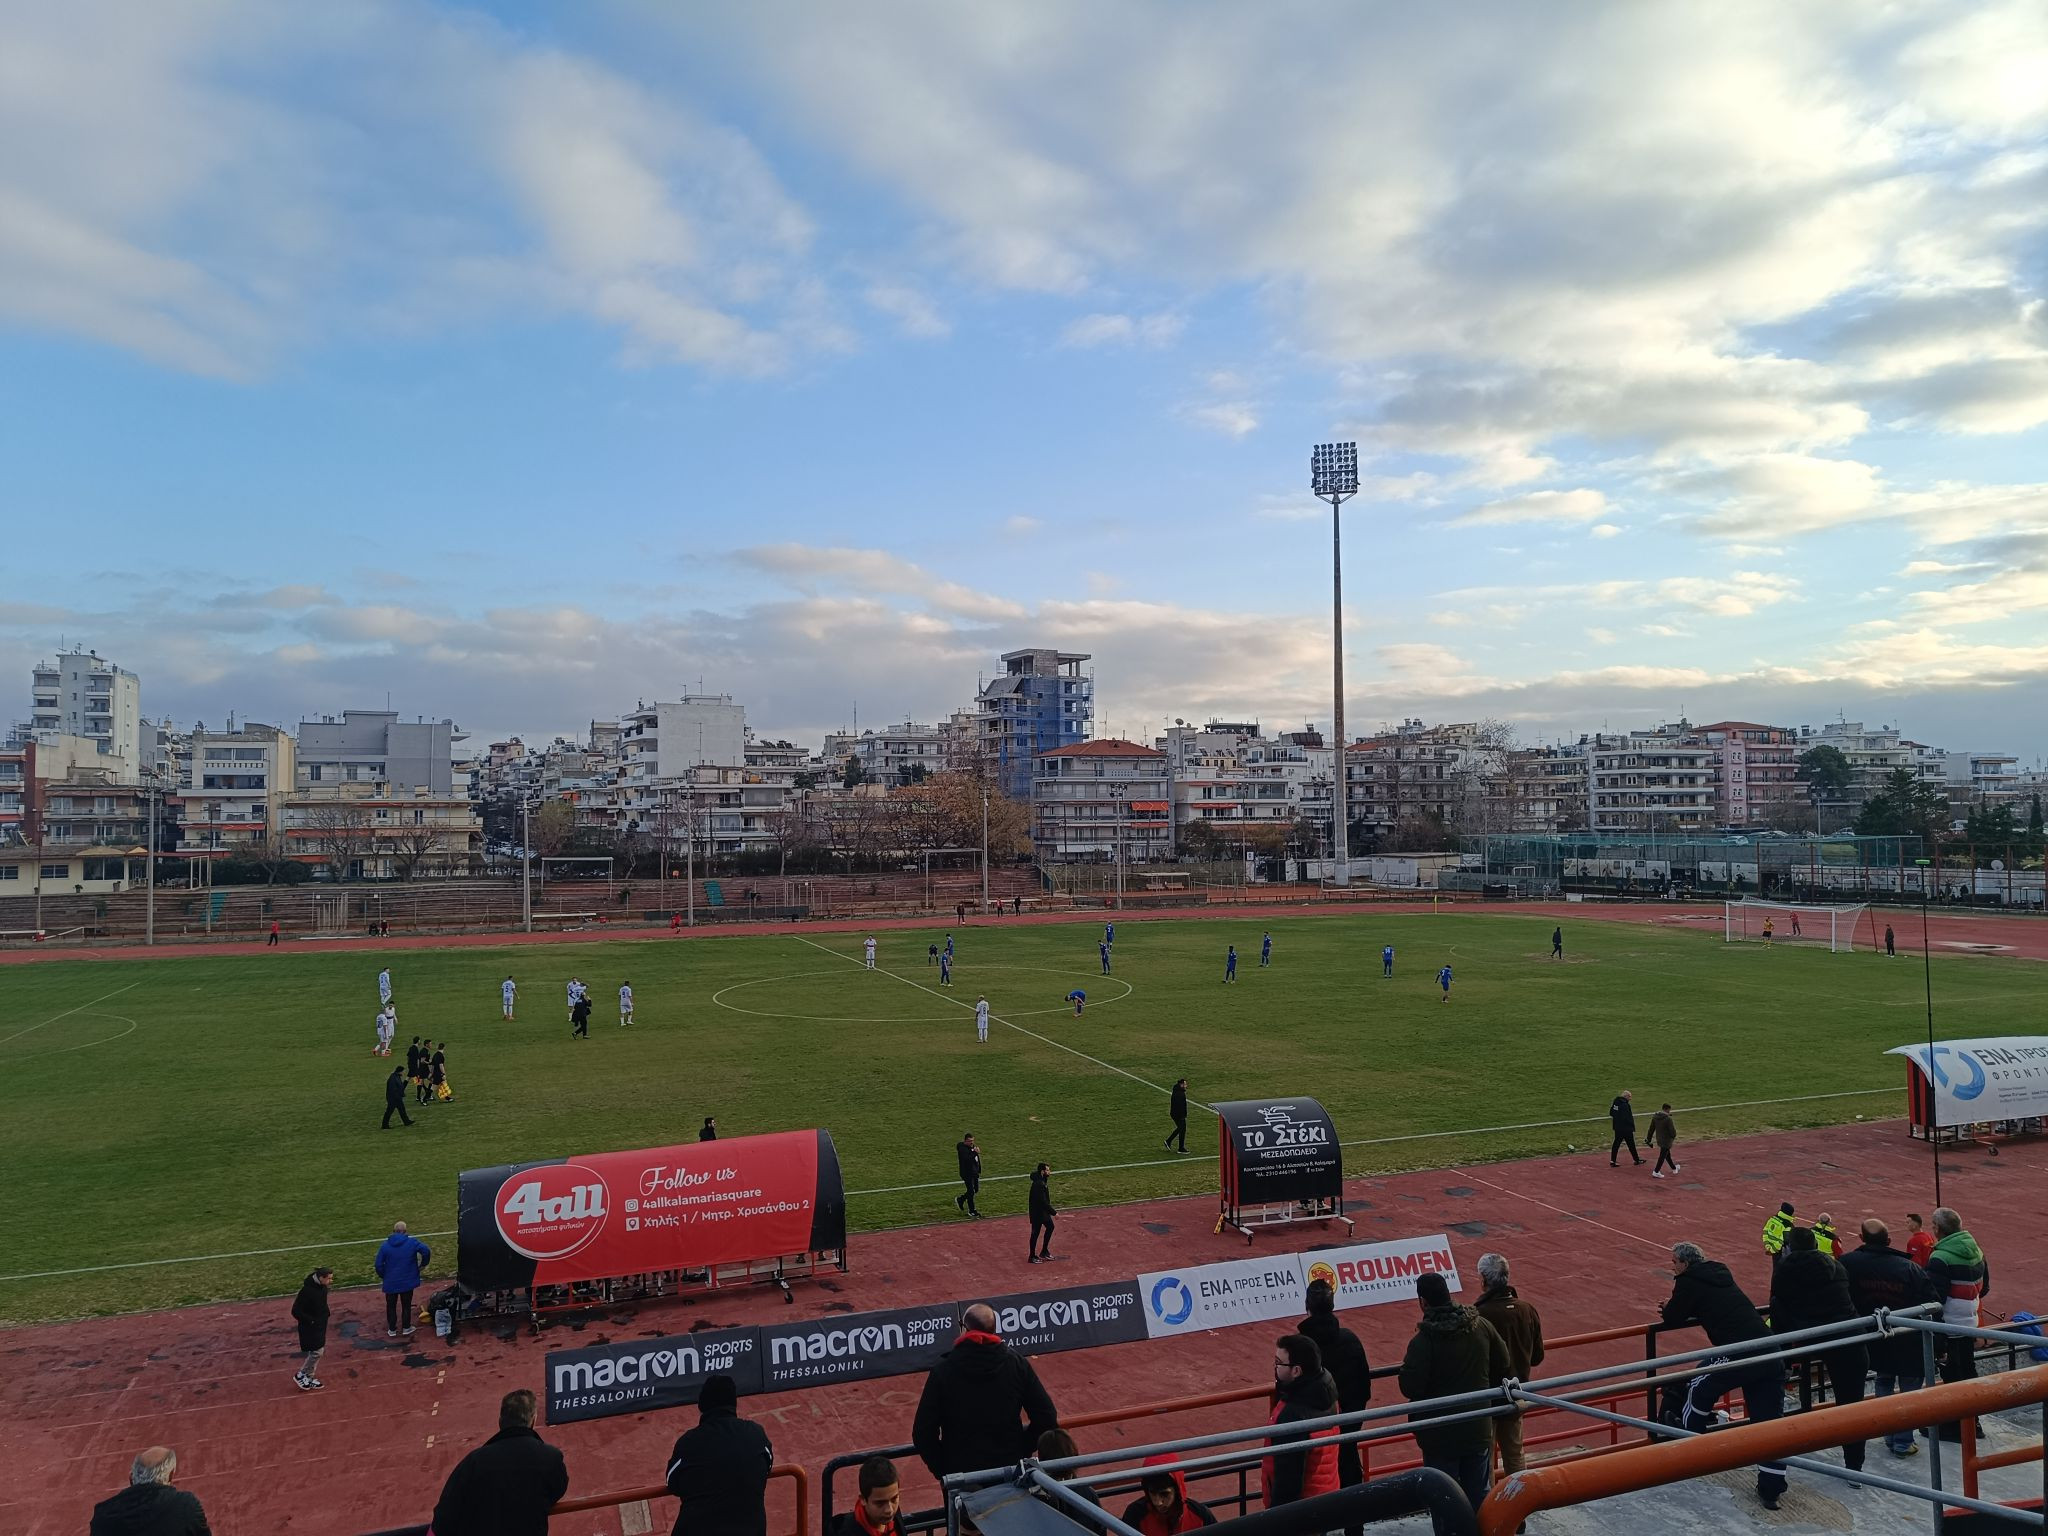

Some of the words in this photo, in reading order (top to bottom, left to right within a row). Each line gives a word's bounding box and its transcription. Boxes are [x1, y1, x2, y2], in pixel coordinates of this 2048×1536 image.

[1260, 1148, 1318, 1159] ΜΕΖΕΔΟΠΩΛΕΙΟ
[639, 1166, 711, 1196] Follow
[716, 1168, 738, 1182] us
[504, 1182, 606, 1225] 4all
[642, 1189, 762, 1209] 4allkalamariasquare
[644, 1214, 680, 1228] Χηλής
[682, 1214, 687, 1223] 1
[701, 1209, 734, 1222] Μητρ.
[737, 1202, 800, 1218] Χρυσάνθου
[803, 1200, 810, 1209] 2
[1336, 1250, 1453, 1285] ROUMEN
[1200, 1278, 1233, 1298] ΕΝΑ
[1234, 1276, 1262, 1290] ΠΡΟΣ
[1264, 1270, 1297, 1288] ΕΝΑ
[1092, 1294, 1134, 1309] SPORTS
[1204, 1291, 1300, 1311] ΦΡΟΝΤΙΣΤΗΡΙΑ
[907, 1317, 952, 1332] SPORTS
[994, 1299, 1091, 1334] acron
[1094, 1308, 1119, 1321] HUB
[703, 1339, 753, 1357] SPORTS
[771, 1324, 905, 1364] macron
[908, 1333, 936, 1347] HUB
[1007, 1333, 1055, 1347] ALONIKI
[554, 1347, 700, 1393] macron
[704, 1356, 734, 1372] HUB
[773, 1360, 865, 1380] THESSALONIKI
[555, 1385, 655, 1410] THESSALONIKI
